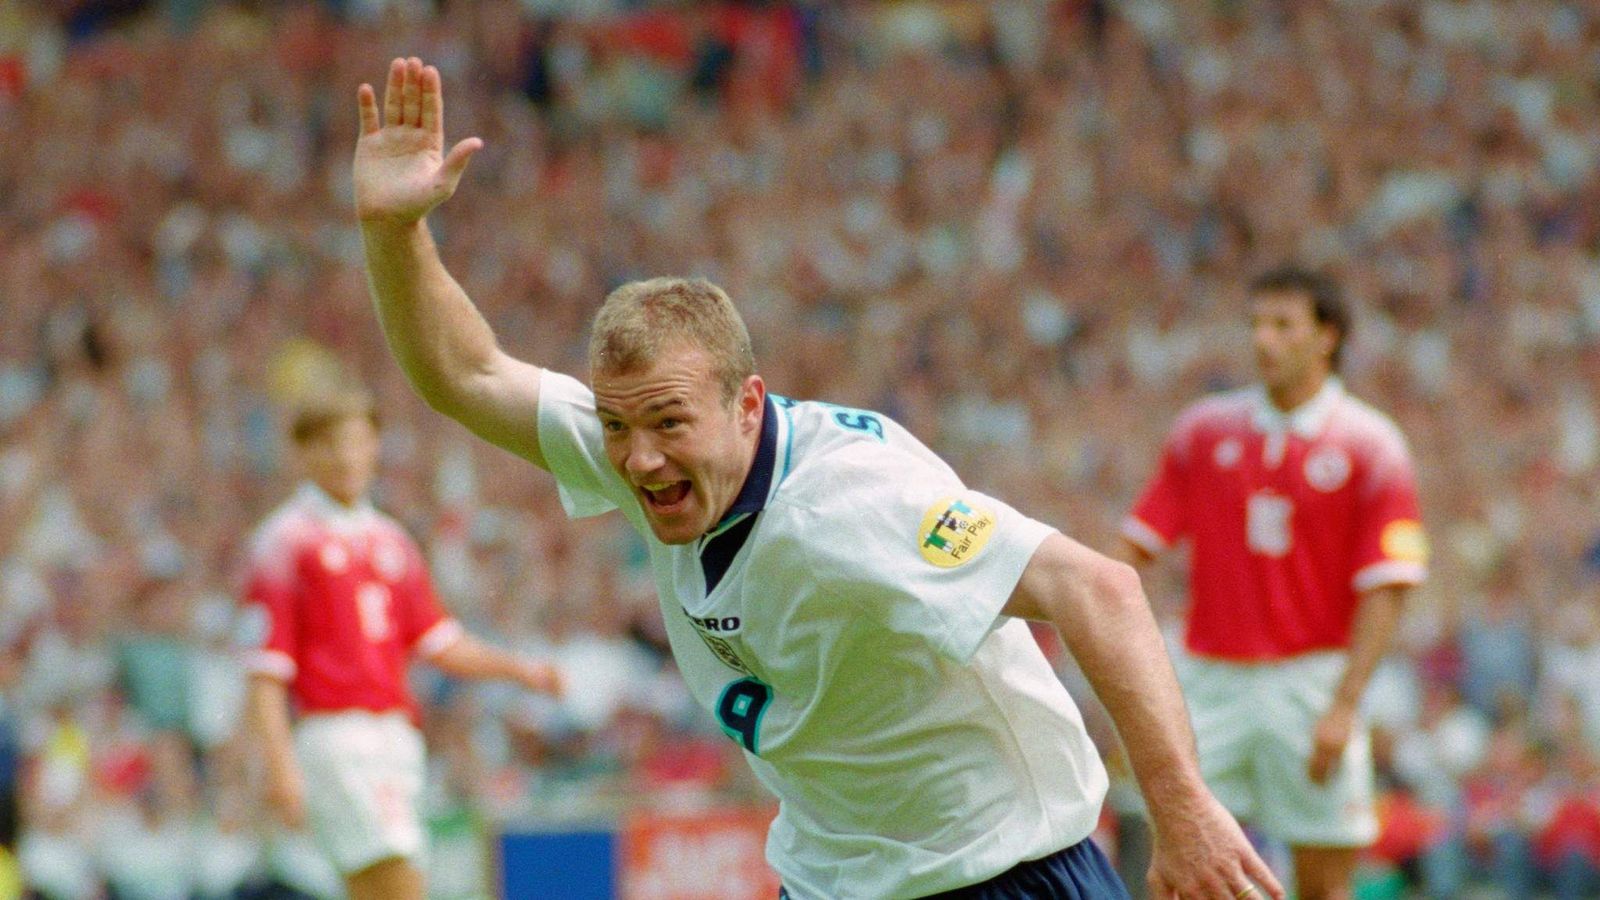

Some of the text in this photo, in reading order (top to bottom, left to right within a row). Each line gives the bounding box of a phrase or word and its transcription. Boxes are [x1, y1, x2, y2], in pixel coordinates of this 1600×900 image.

[950, 516, 992, 560] Fair Play
[714, 676, 773, 757] 9
